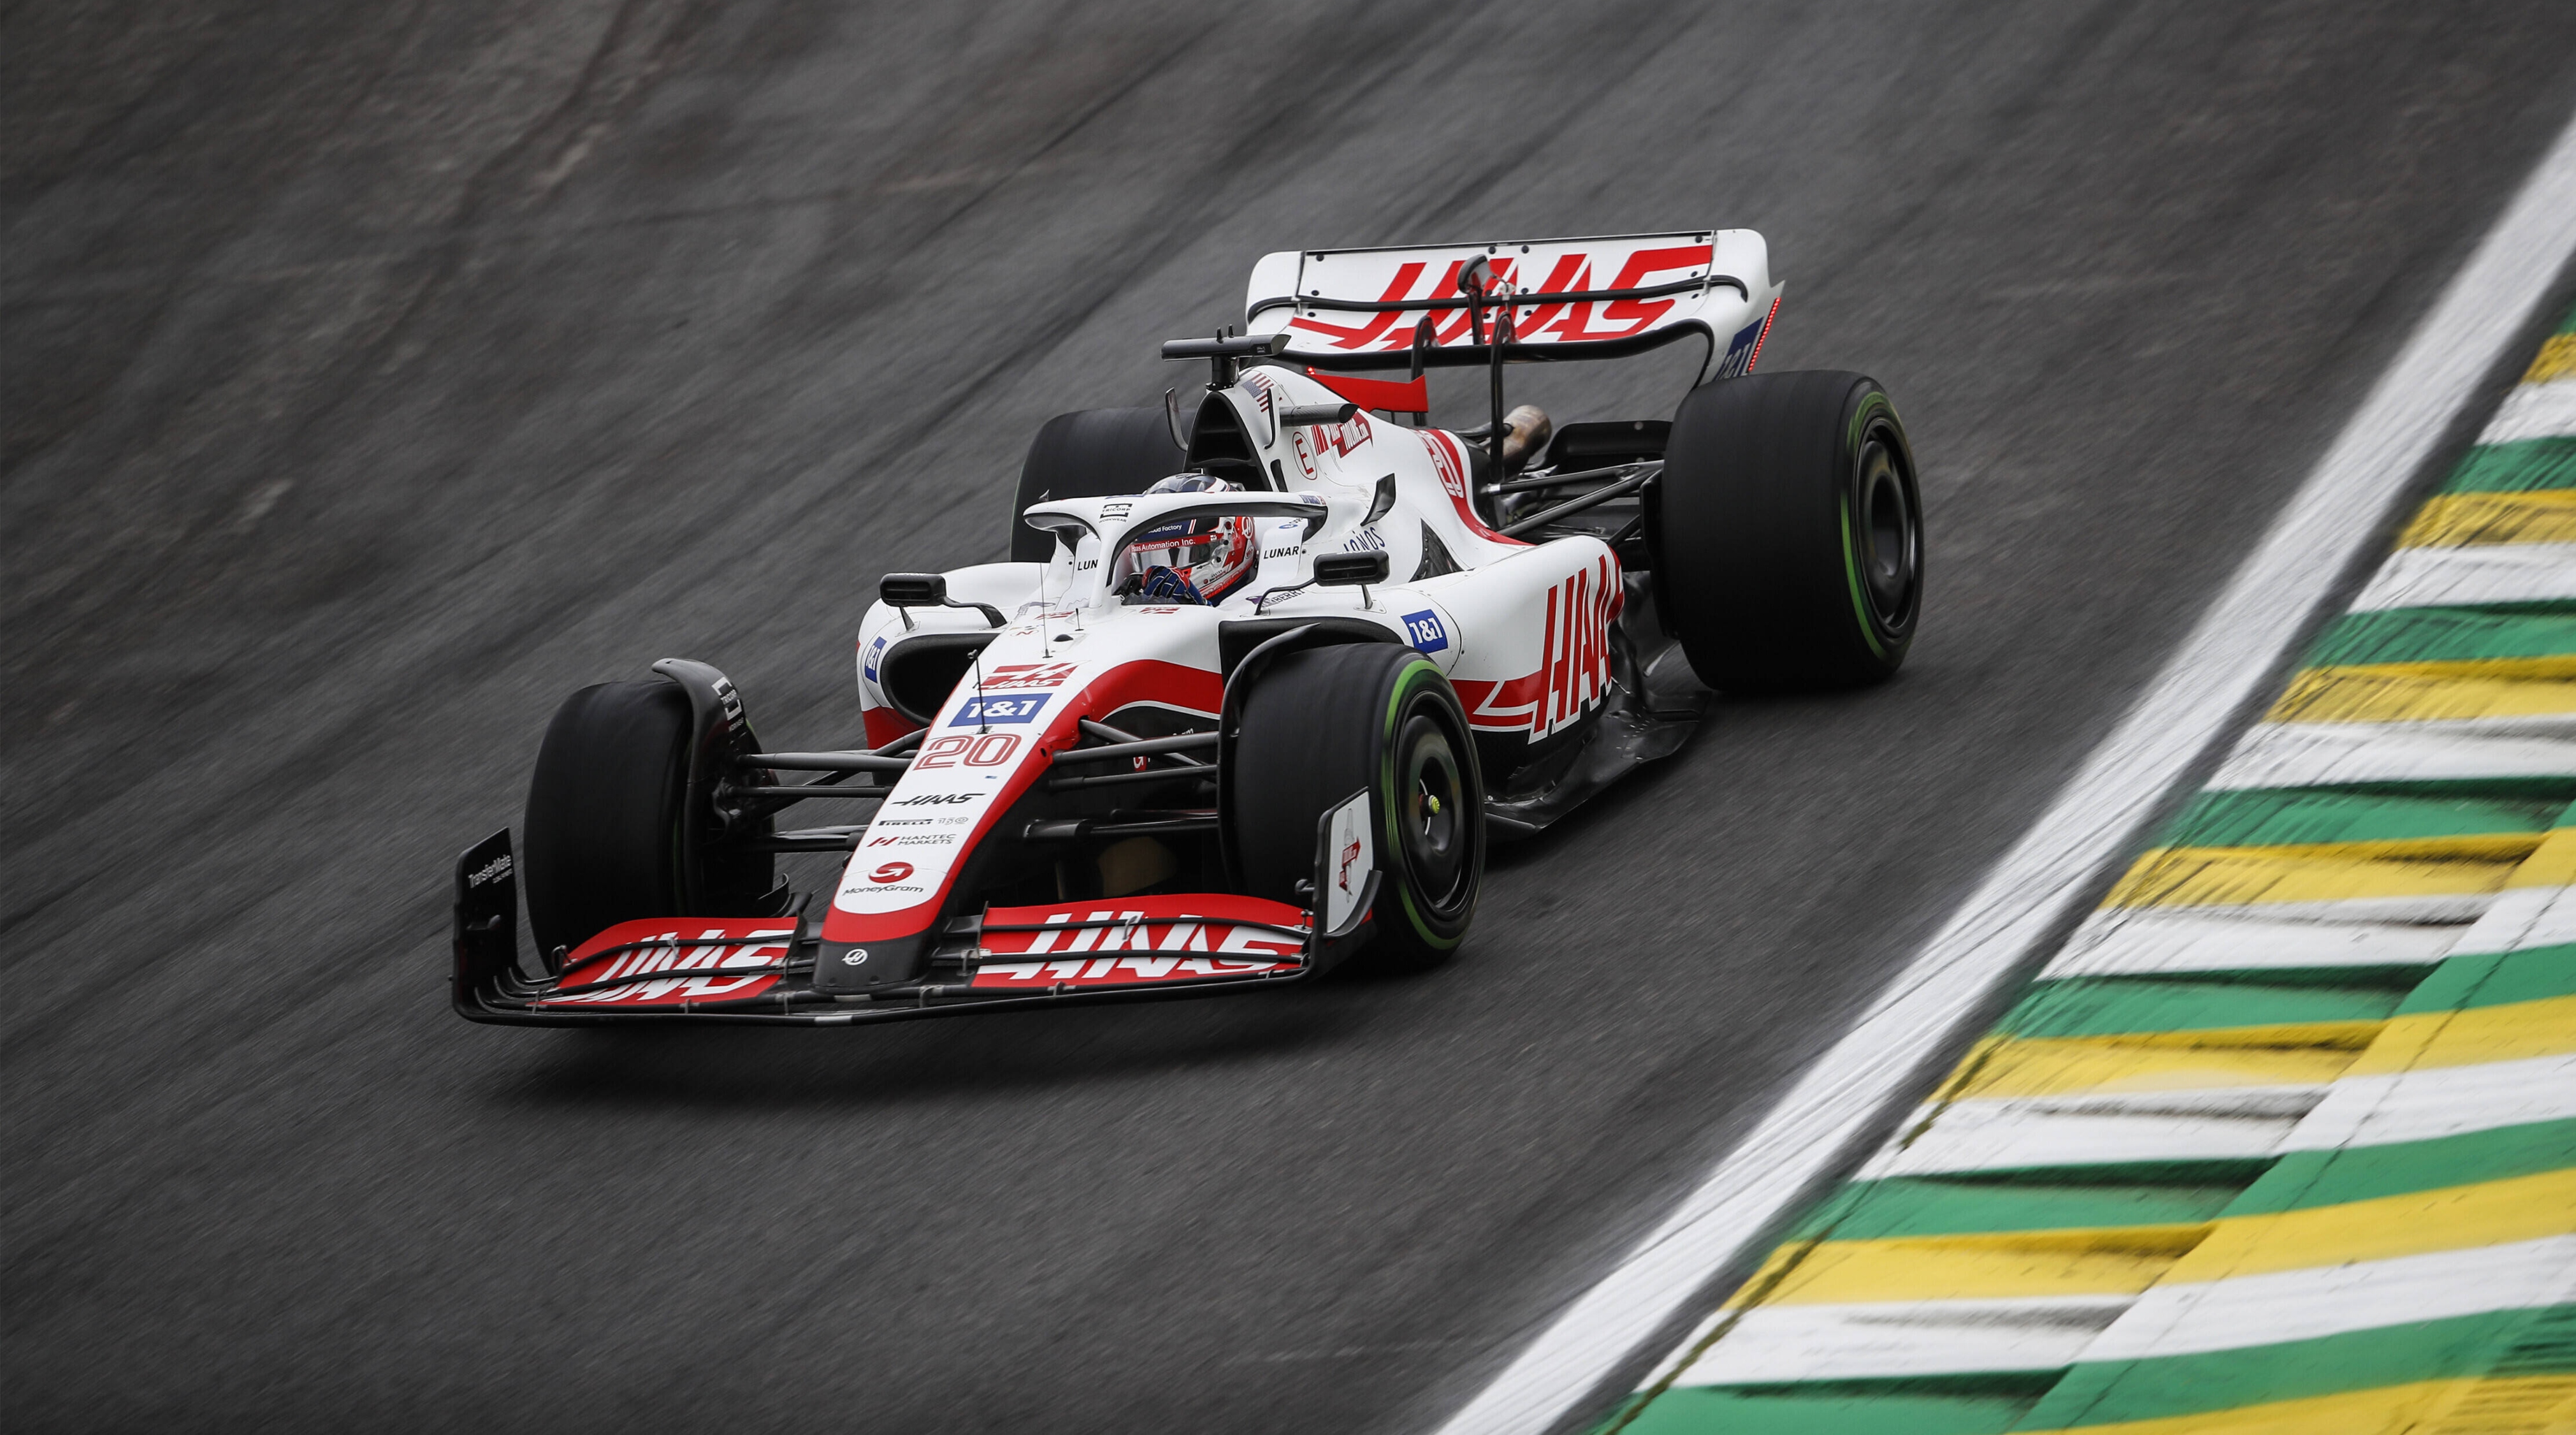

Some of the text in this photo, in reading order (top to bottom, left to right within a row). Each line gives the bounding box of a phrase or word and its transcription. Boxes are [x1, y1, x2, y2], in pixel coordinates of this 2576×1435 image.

[1289, 245, 1714, 351] HAAS
[1141, 541, 1180, 551] Automation
[1264, 546, 1299, 559] LUNAR
[1077, 559, 1098, 571] LUN
[1408, 617, 1444, 644] 1&1
[865, 645, 881, 671] 1&1
[981, 679, 1054, 690] HAAS
[967, 699, 1038, 718] 1&1
[913, 734, 1022, 771] 20
[890, 793, 987, 806] HAAS
[842, 884, 923, 896] MoneyGram
[977, 911, 1304, 980] HAAS
[539, 929, 794, 1003] HAAS
